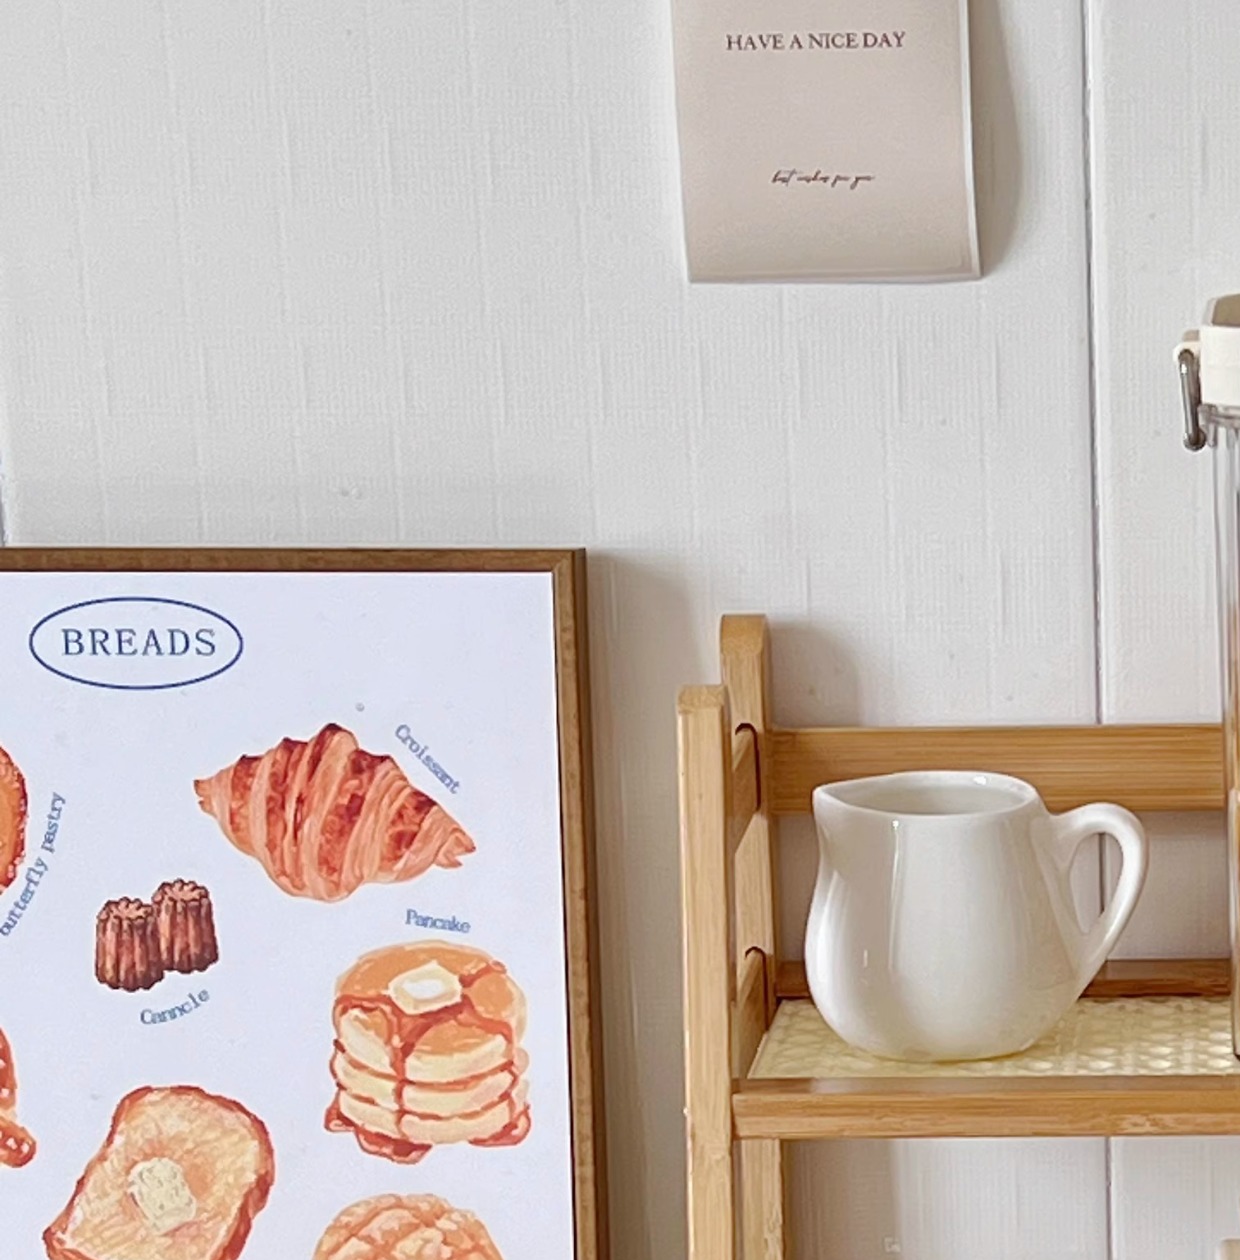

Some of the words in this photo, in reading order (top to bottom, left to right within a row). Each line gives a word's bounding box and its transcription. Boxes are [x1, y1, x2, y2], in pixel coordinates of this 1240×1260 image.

[725, 33, 786, 51] HAVE
[789, 34, 804, 50] A
[808, 32, 860, 50] NICE
[862, 31, 906, 49] DAY
[61, 628, 217, 656] BREADS
[395, 724, 460, 795] Croissant
[41, 791, 66, 854] pastry
[405, 908, 471, 933] Pancake
